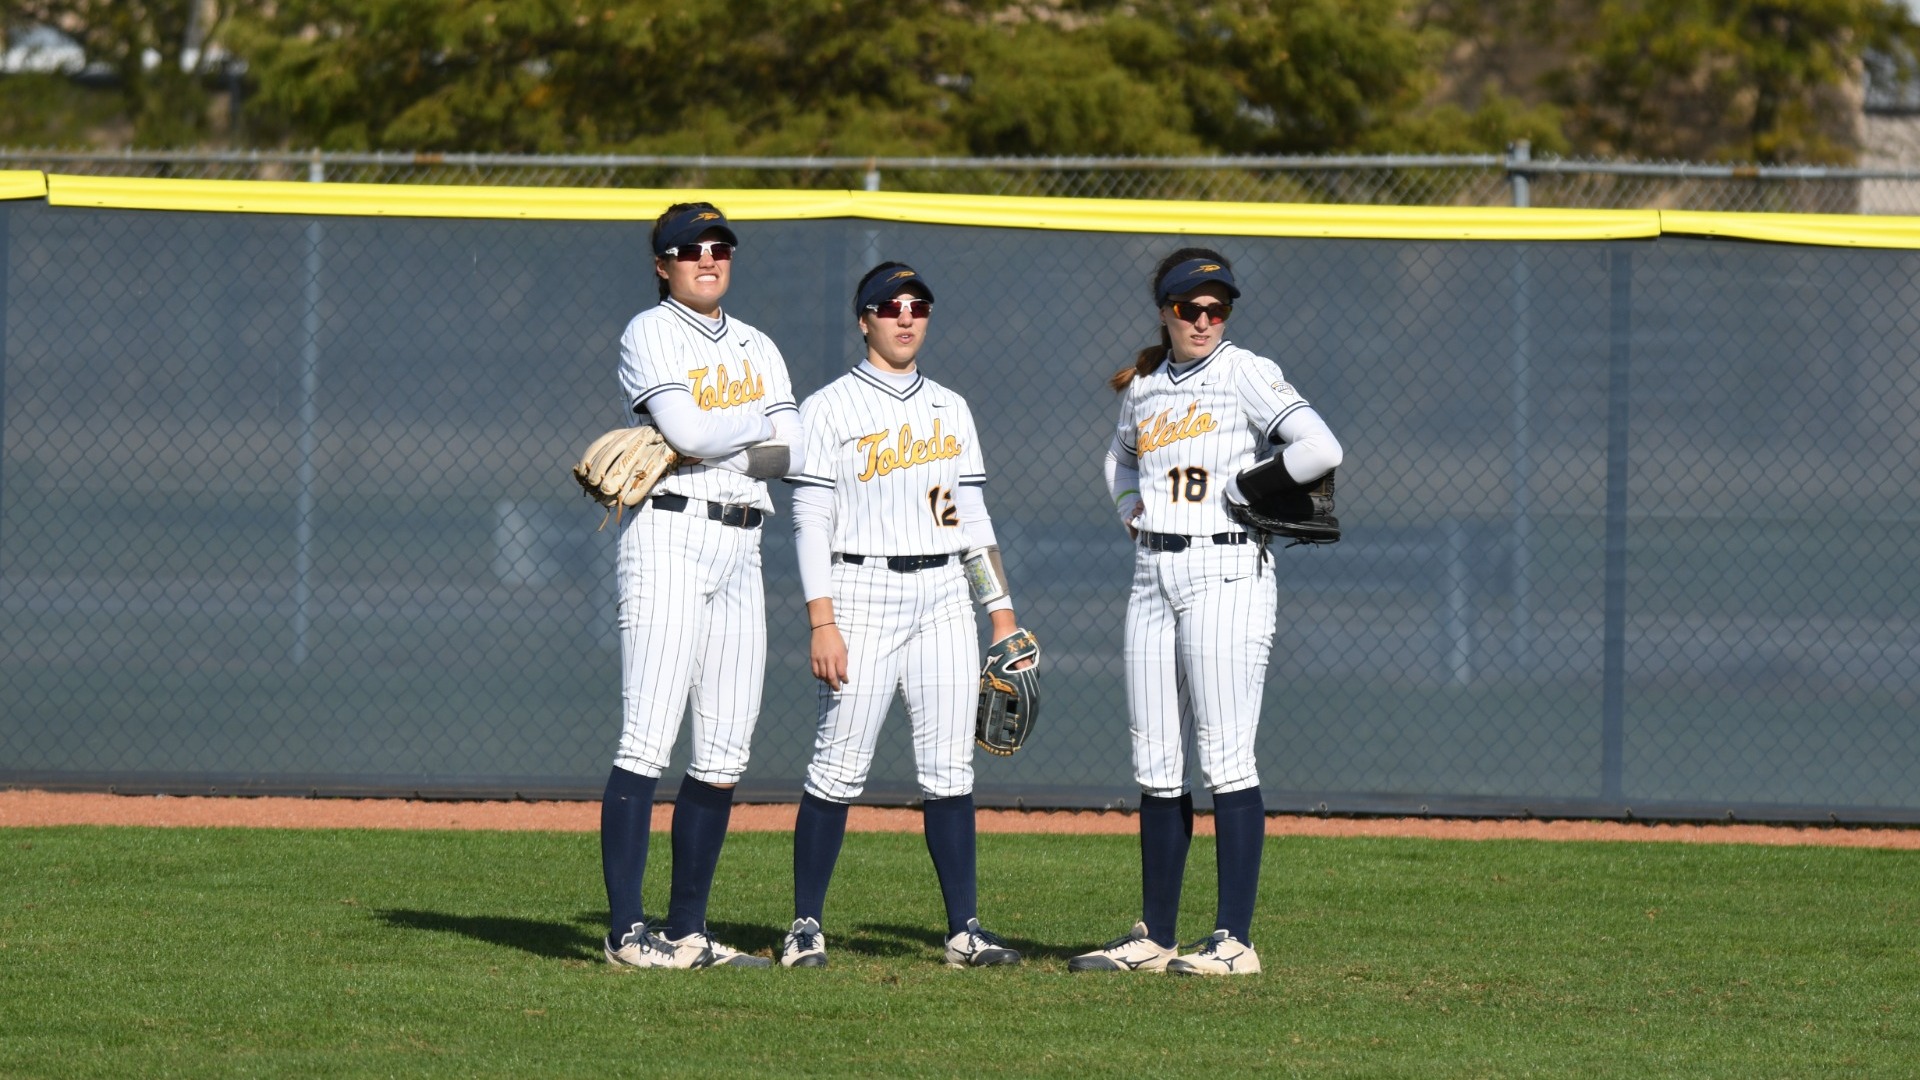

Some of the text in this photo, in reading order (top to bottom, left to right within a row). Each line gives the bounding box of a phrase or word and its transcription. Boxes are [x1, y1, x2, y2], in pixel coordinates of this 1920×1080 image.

[857, 418, 961, 482] Toledo
[928, 484, 960, 528] 12
[1168, 465, 1208, 503] 18
